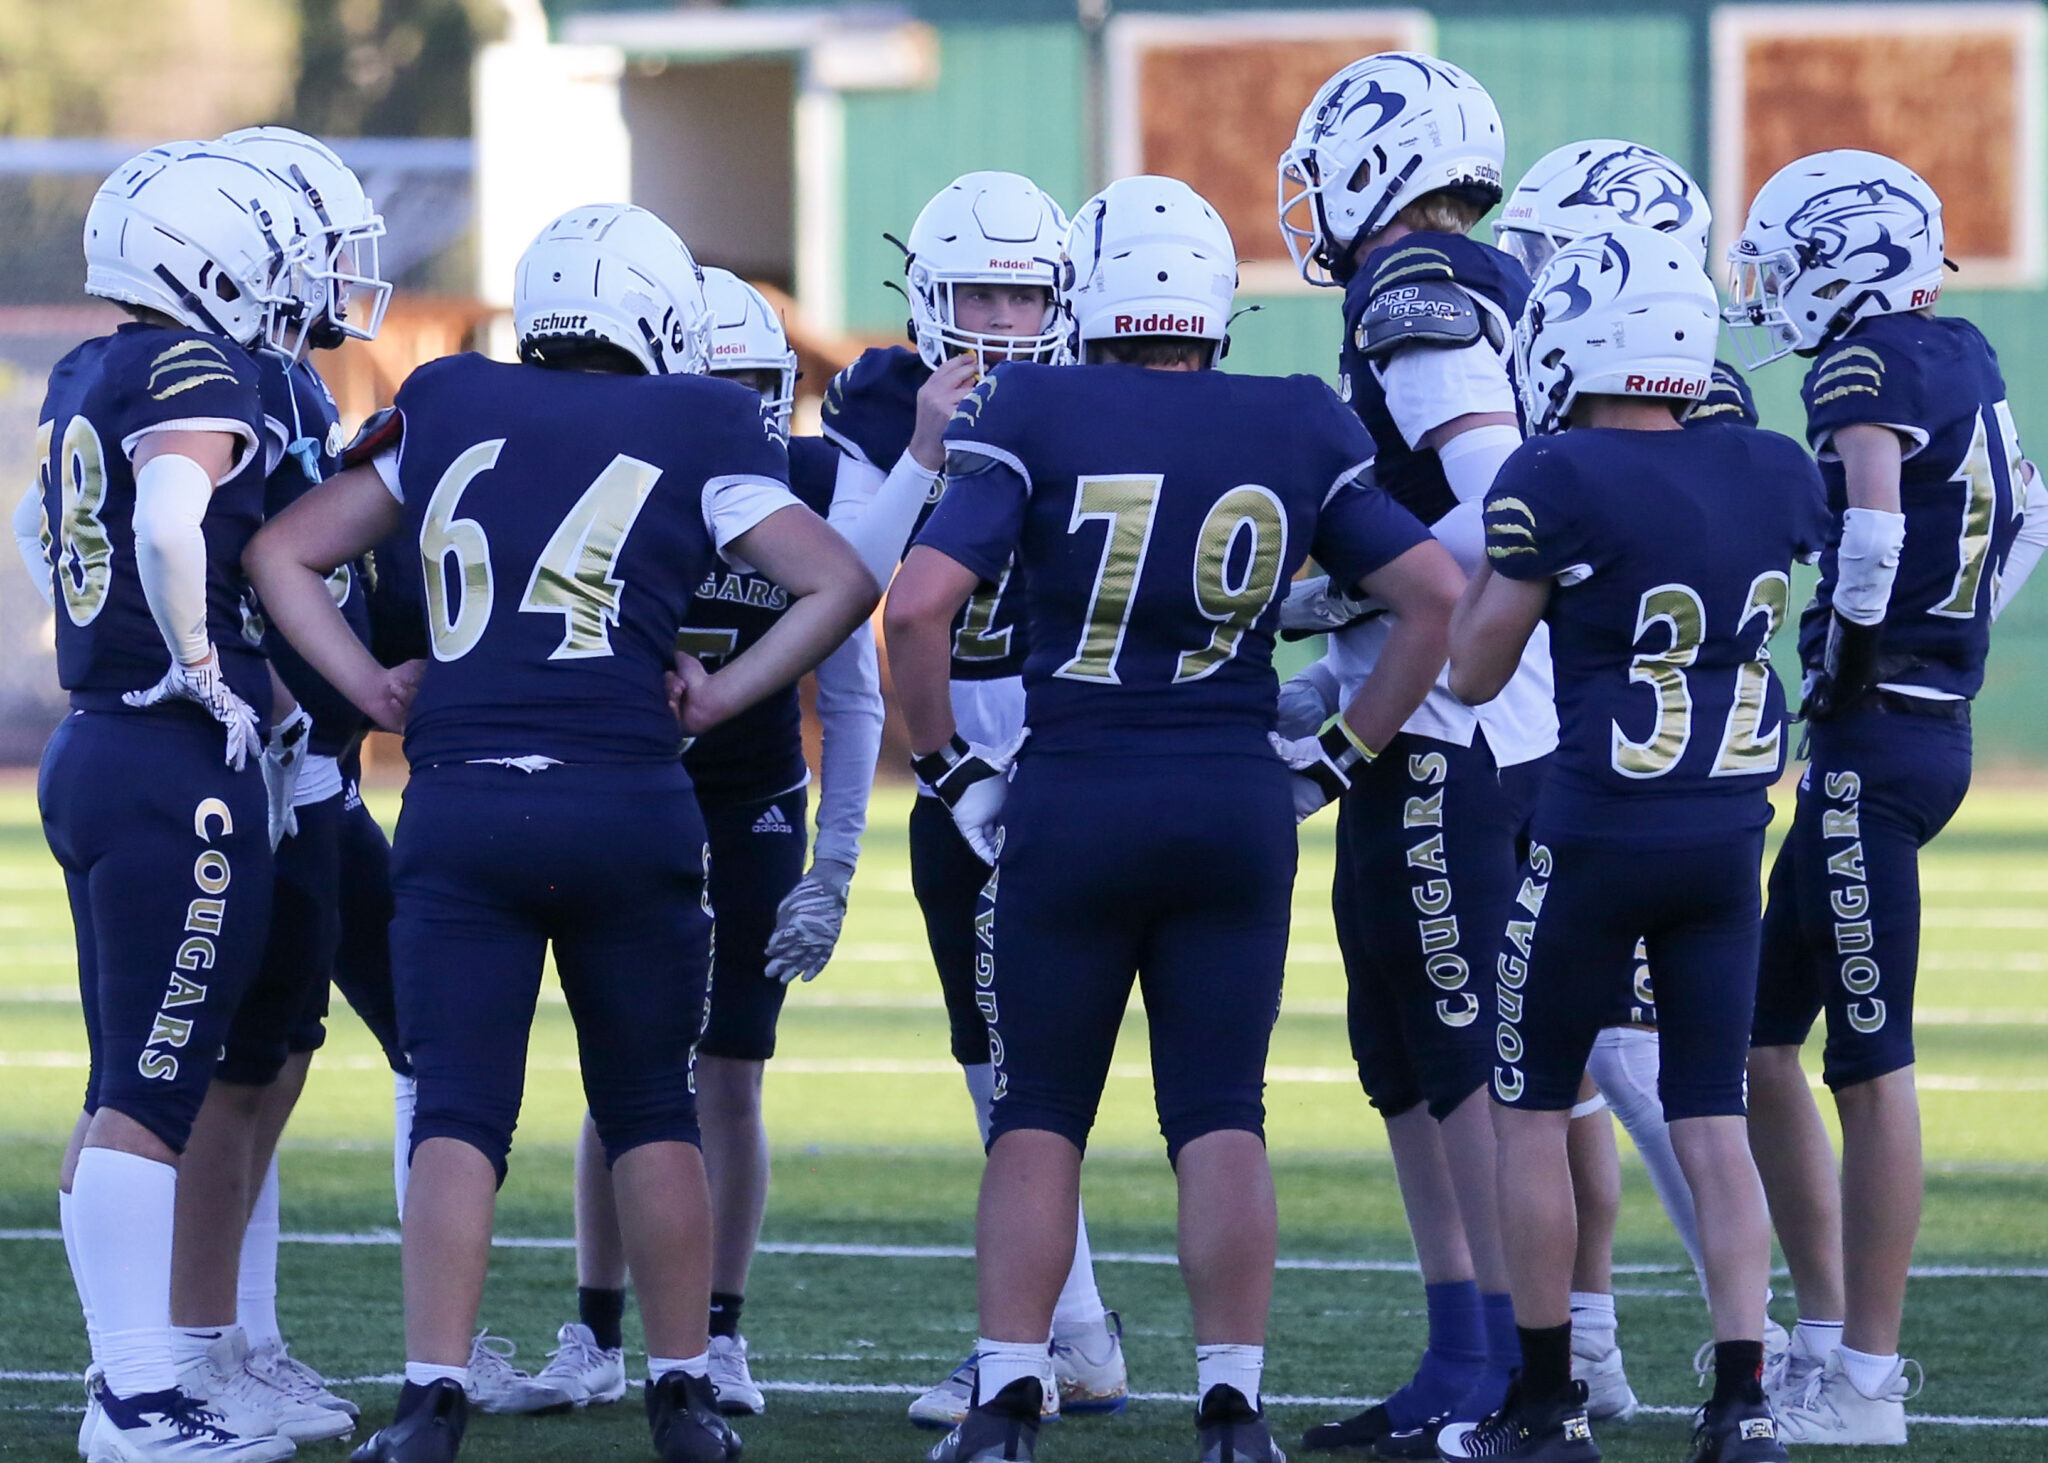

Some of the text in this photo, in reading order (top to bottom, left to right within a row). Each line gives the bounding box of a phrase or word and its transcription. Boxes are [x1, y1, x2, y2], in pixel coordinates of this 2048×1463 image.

[989, 258, 1034, 270] Riddell
[1371, 286, 1419, 312] PRO
[1389, 300, 1455, 321] GEAR
[532, 313, 587, 331] schutt
[1115, 314, 1204, 333] Riddell
[715, 344, 746, 355] ddell
[1625, 374, 1706, 398] Riddell
[419, 438, 663, 662] 64
[695, 572, 788, 610] GARS
[1052, 473, 1288, 686] 79
[1611, 570, 1790, 780] 32
[1403, 752, 1479, 1027] COUGARS
[1824, 770, 1886, 1034] COUGARS
[138, 797, 233, 1081] COUGARS
[1494, 840, 1553, 1102] COUGARS
